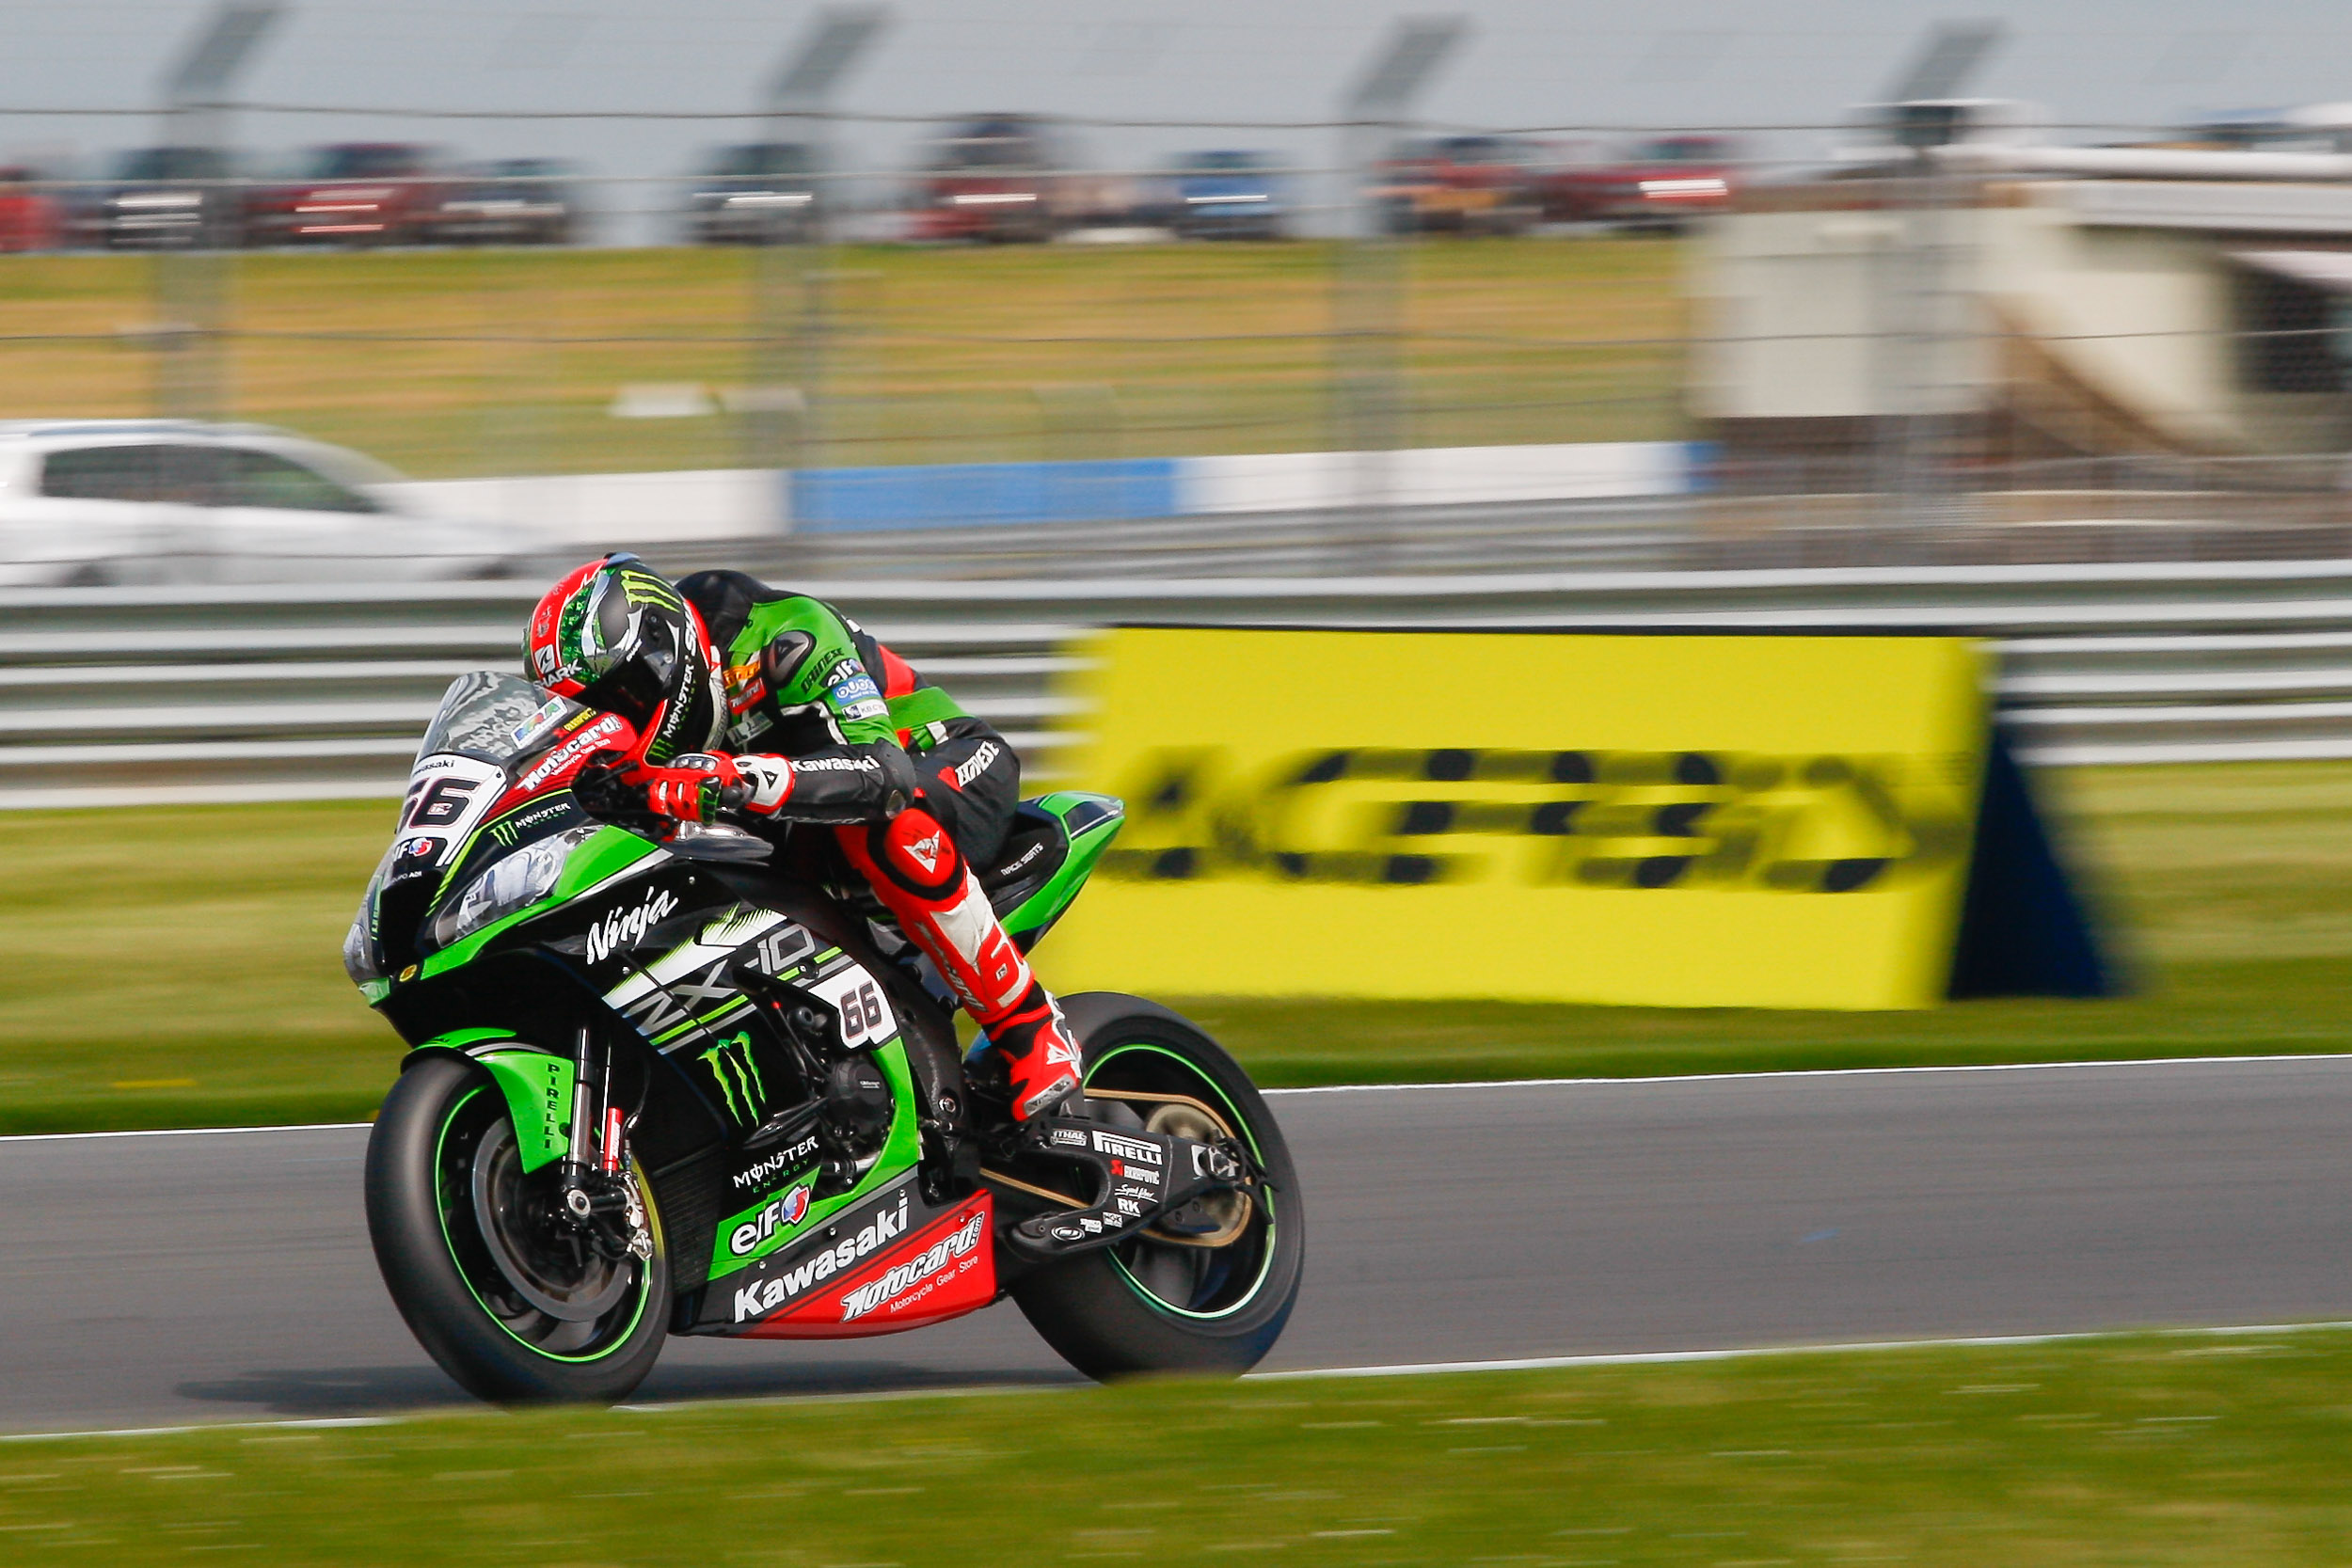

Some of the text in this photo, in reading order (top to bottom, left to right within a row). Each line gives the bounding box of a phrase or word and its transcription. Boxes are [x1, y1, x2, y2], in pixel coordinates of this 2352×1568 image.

[532, 658, 583, 691] SHARK
[662, 663, 694, 738] MONSTER
[790, 754, 882, 772] Kawasaki
[514, 802, 572, 829] MONSTER
[586, 885, 679, 965] Ninja
[840, 980, 883, 1040] 66
[543, 1062, 561, 1149] PIRELLI
[733, 1135, 819, 1188] MONSTER
[1091, 1130, 1163, 1165] PIRELLI
[1117, 1197, 1140, 1214] RK
[734, 1196, 909, 1323] Kawasaki
[890, 1255, 978, 1313] Motorcycle Gear Store
